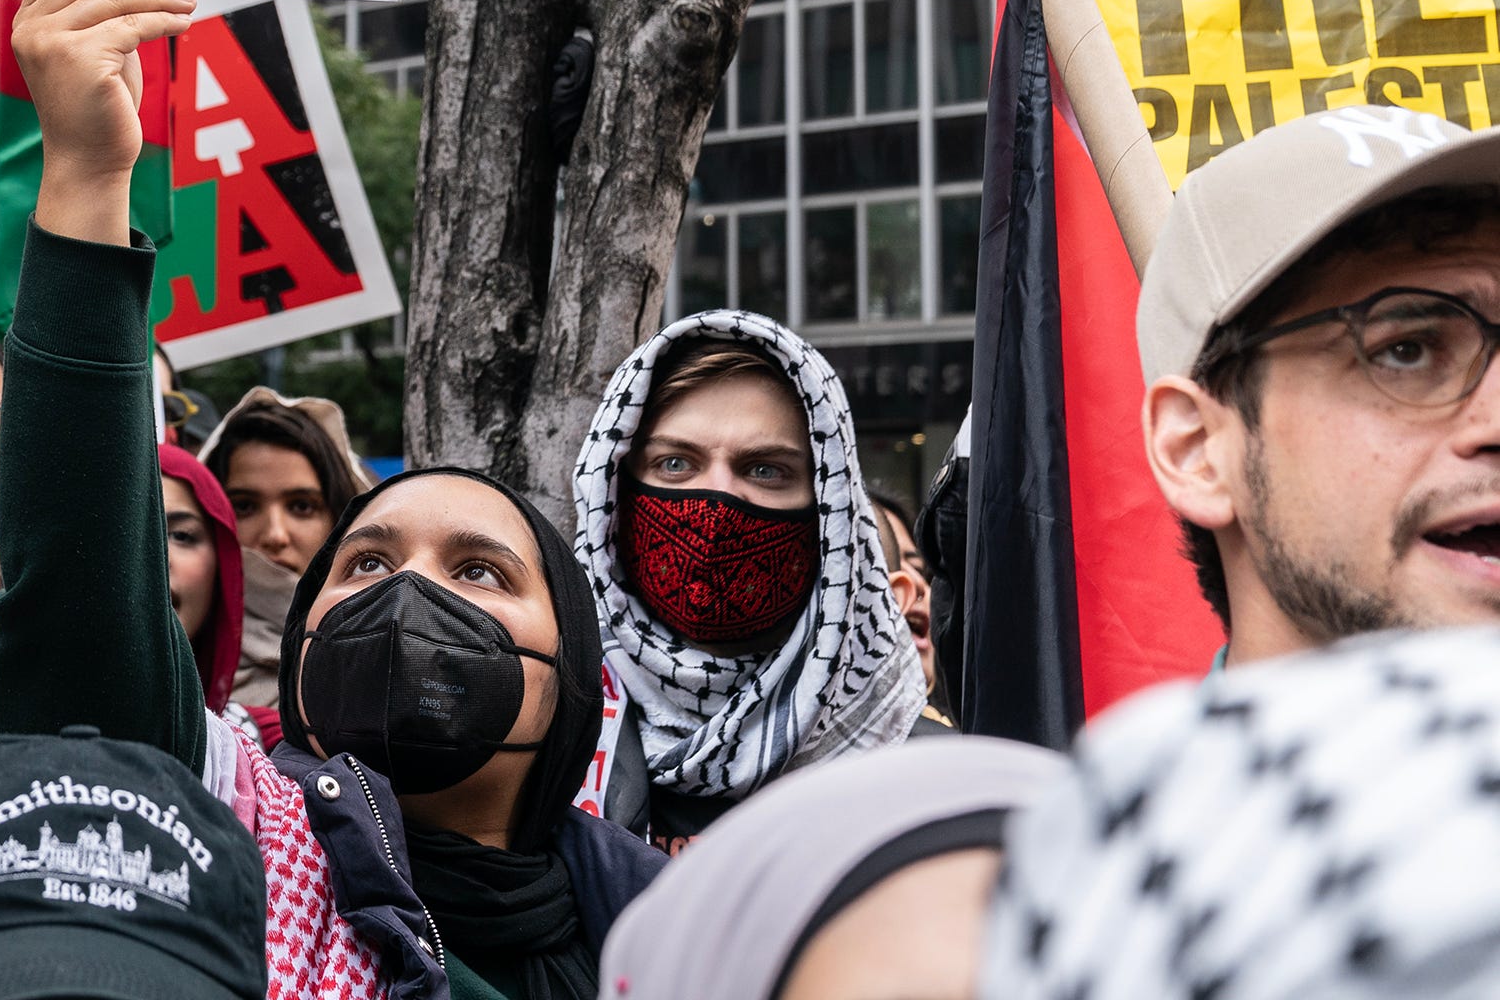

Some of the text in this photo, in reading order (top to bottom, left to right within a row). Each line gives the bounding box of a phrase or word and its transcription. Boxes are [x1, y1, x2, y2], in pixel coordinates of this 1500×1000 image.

[837, 362, 964, 396] TERS
[42, 877, 137, 912] Est. 1846
